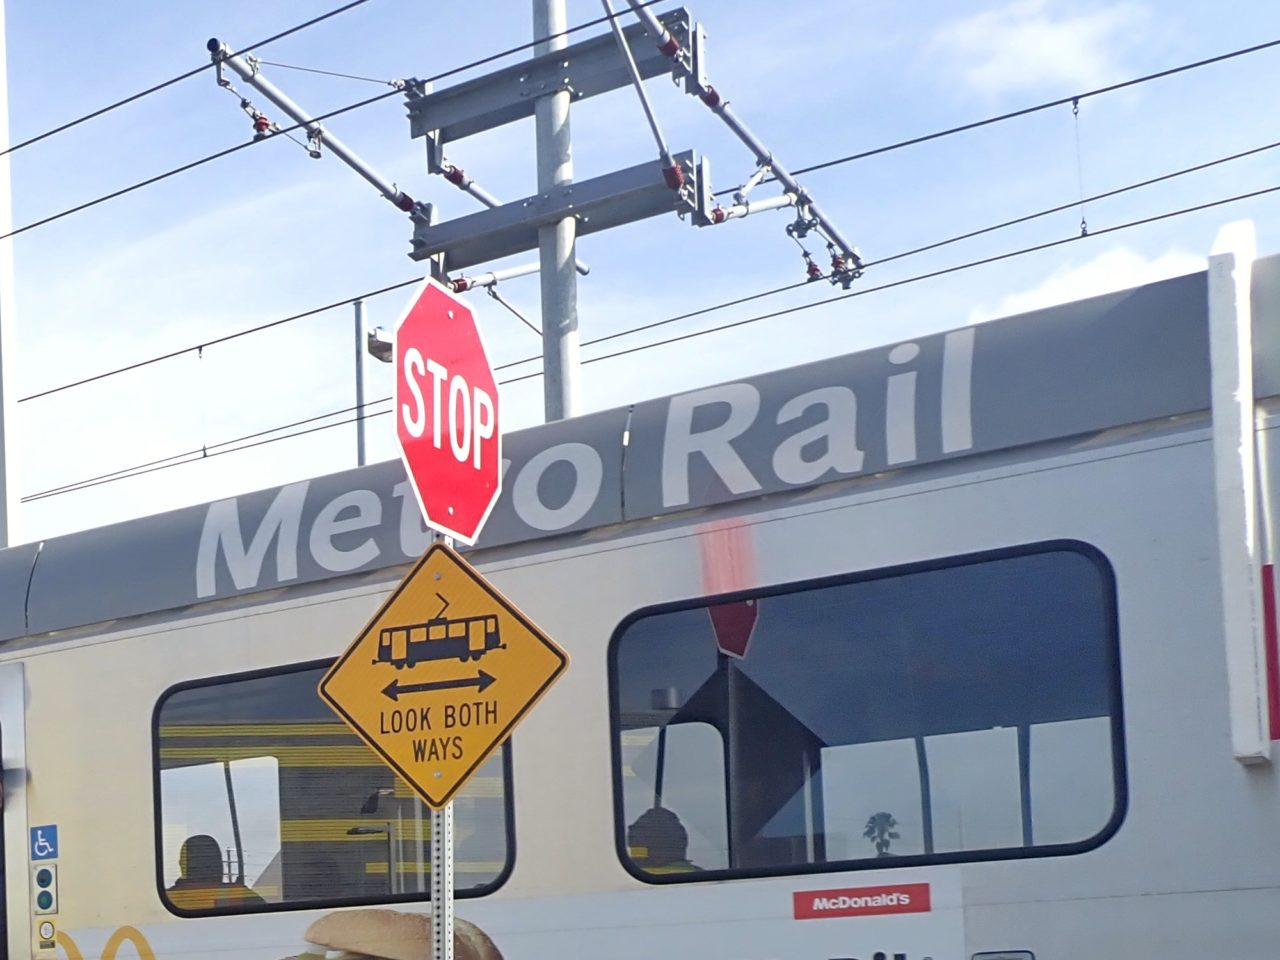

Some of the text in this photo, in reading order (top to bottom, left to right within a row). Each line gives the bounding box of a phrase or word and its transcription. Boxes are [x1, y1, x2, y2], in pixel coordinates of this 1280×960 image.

[402, 347, 495, 470] STOP
[195, 328, 976, 599] Meto Rail
[380, 701, 498, 734] LOOK BOTH
[412, 736, 464, 763] WAYS
[812, 892, 911, 911] McDonald's
